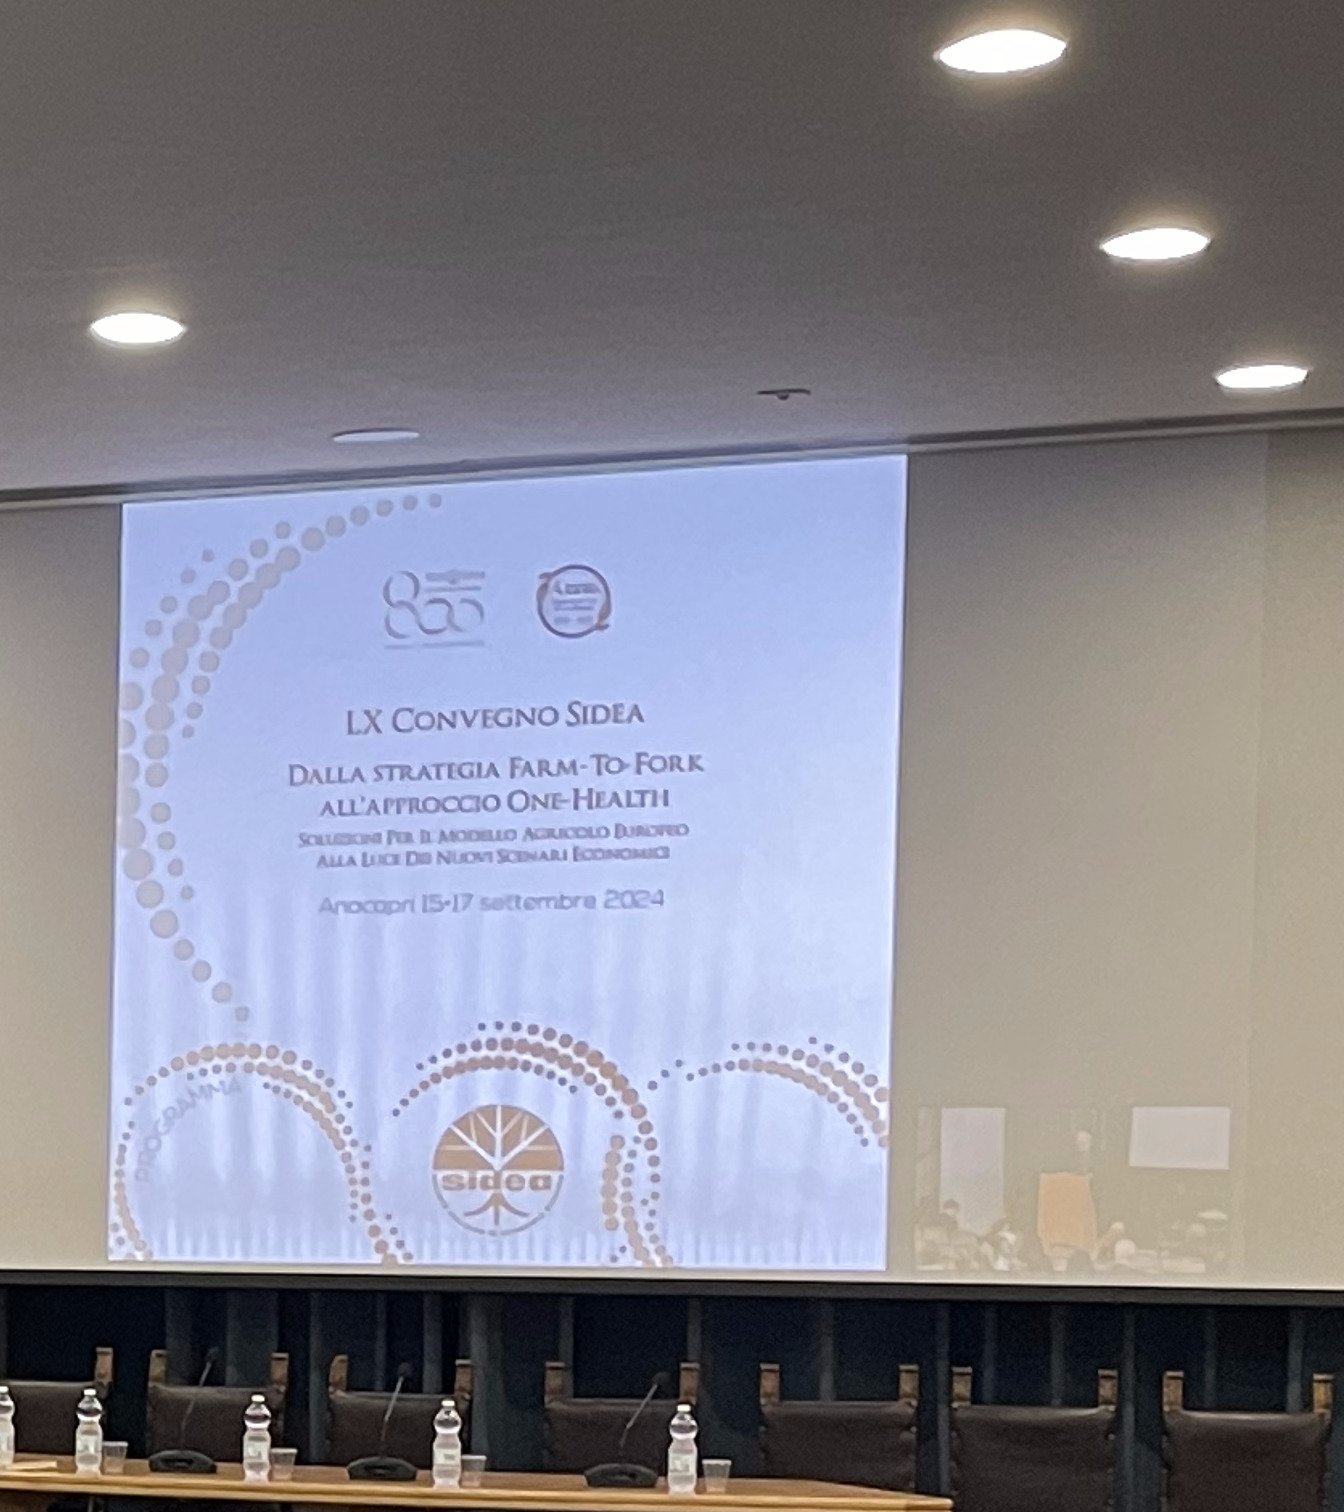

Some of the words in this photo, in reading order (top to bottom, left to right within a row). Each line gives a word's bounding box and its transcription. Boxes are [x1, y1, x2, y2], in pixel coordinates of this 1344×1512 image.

[346, 708, 383, 736] LX
[392, 704, 560, 734] CONVEGNO
[565, 700, 645, 728] SIDEA
[288, 763, 366, 787] DALLA
[373, 761, 500, 783] STRATEGIA
[479, 893, 597, 913] settembre
[603, 889, 665, 910] 2024
